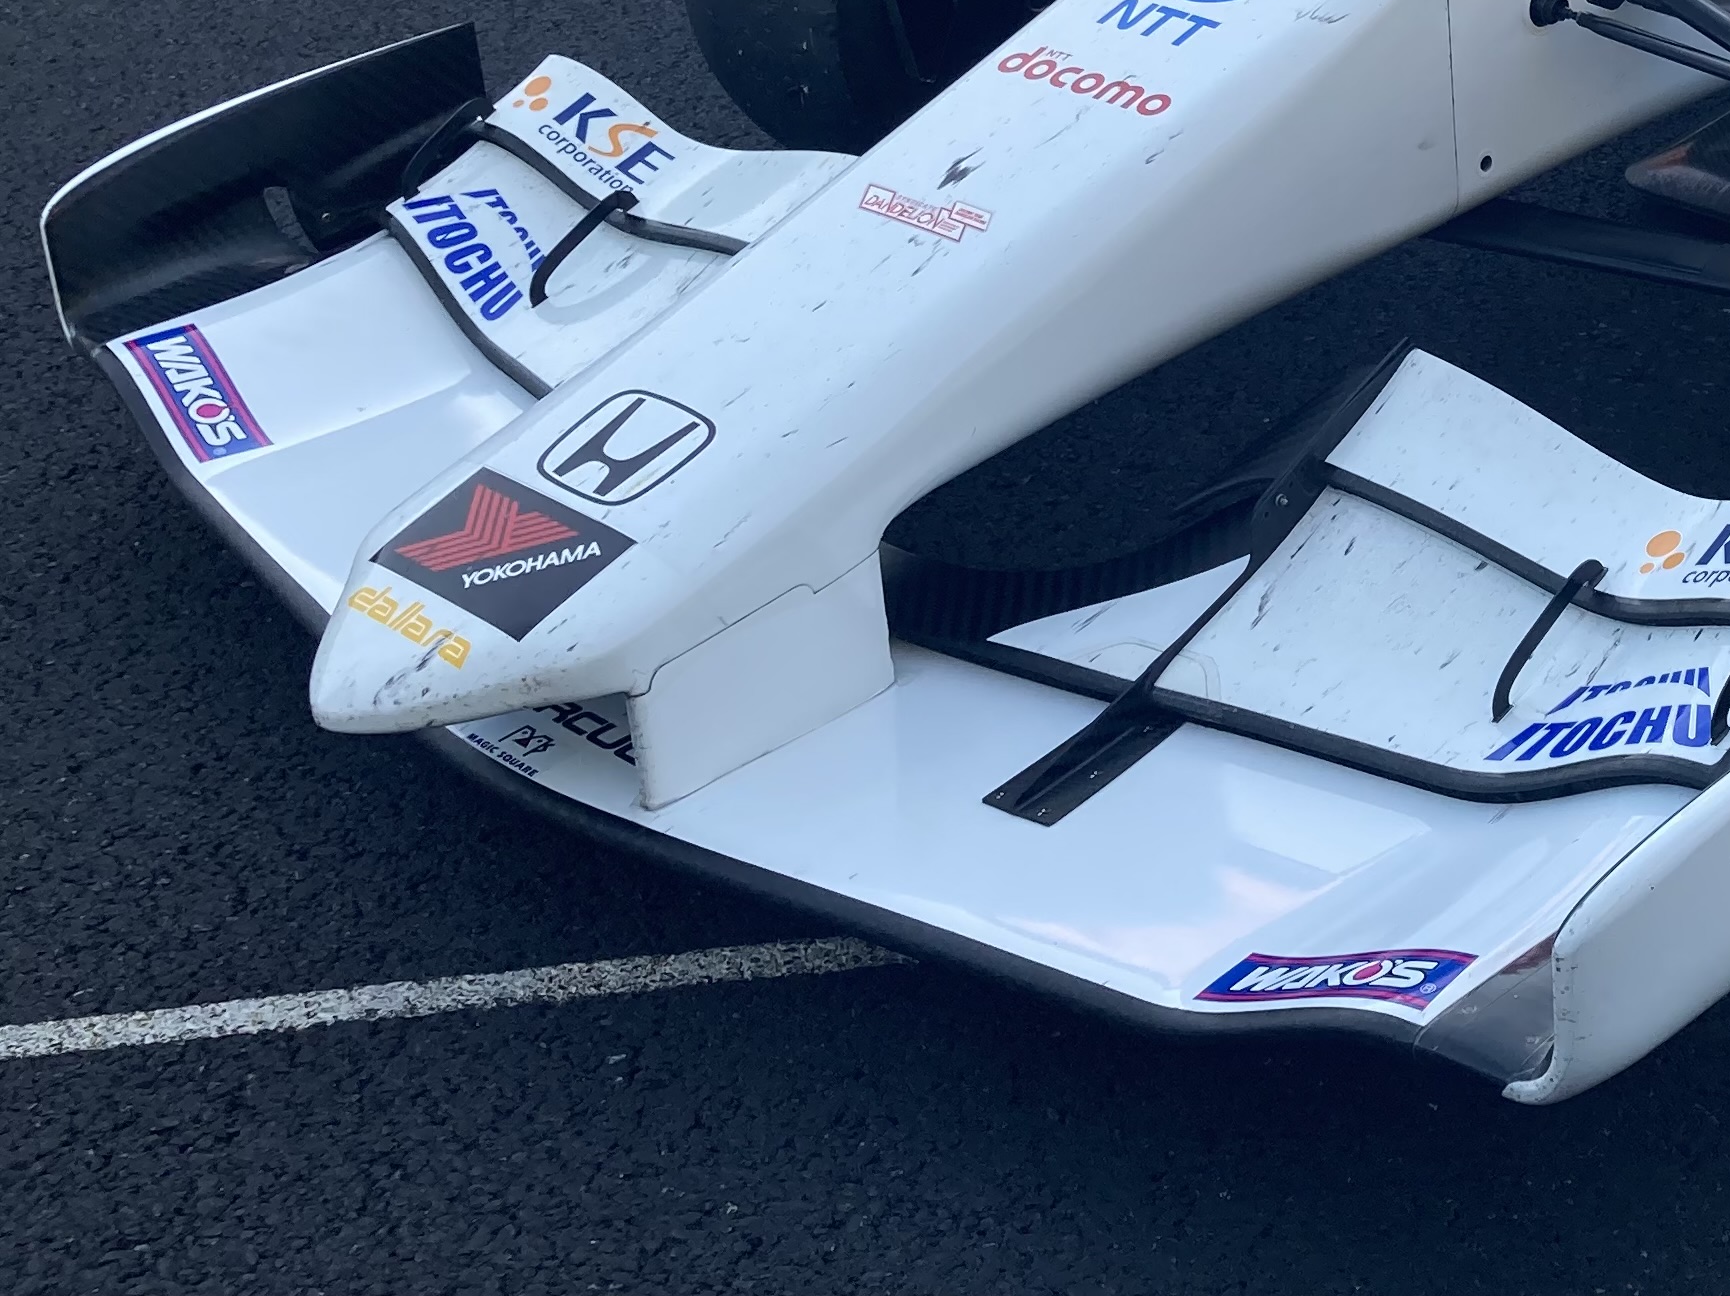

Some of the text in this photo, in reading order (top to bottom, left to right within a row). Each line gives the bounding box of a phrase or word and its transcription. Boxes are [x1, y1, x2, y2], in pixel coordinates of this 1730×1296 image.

[997, 46, 1172, 117] docomo
[1046, 48, 1073, 61] NTT
[537, 122, 634, 193] corporation
[552, 92, 675, 186] KSE
[402, 195, 524, 322] ITOCHU
[147, 335, 247, 447] WAKO'S
[461, 541, 602, 590] YOKOHAMA
[347, 585, 472, 670] dallara
[466, 732, 540, 778] MAGIC SQUARE
[1484, 704, 1712, 762] ITOCHU
[1229, 959, 1439, 992] WAKO'S
